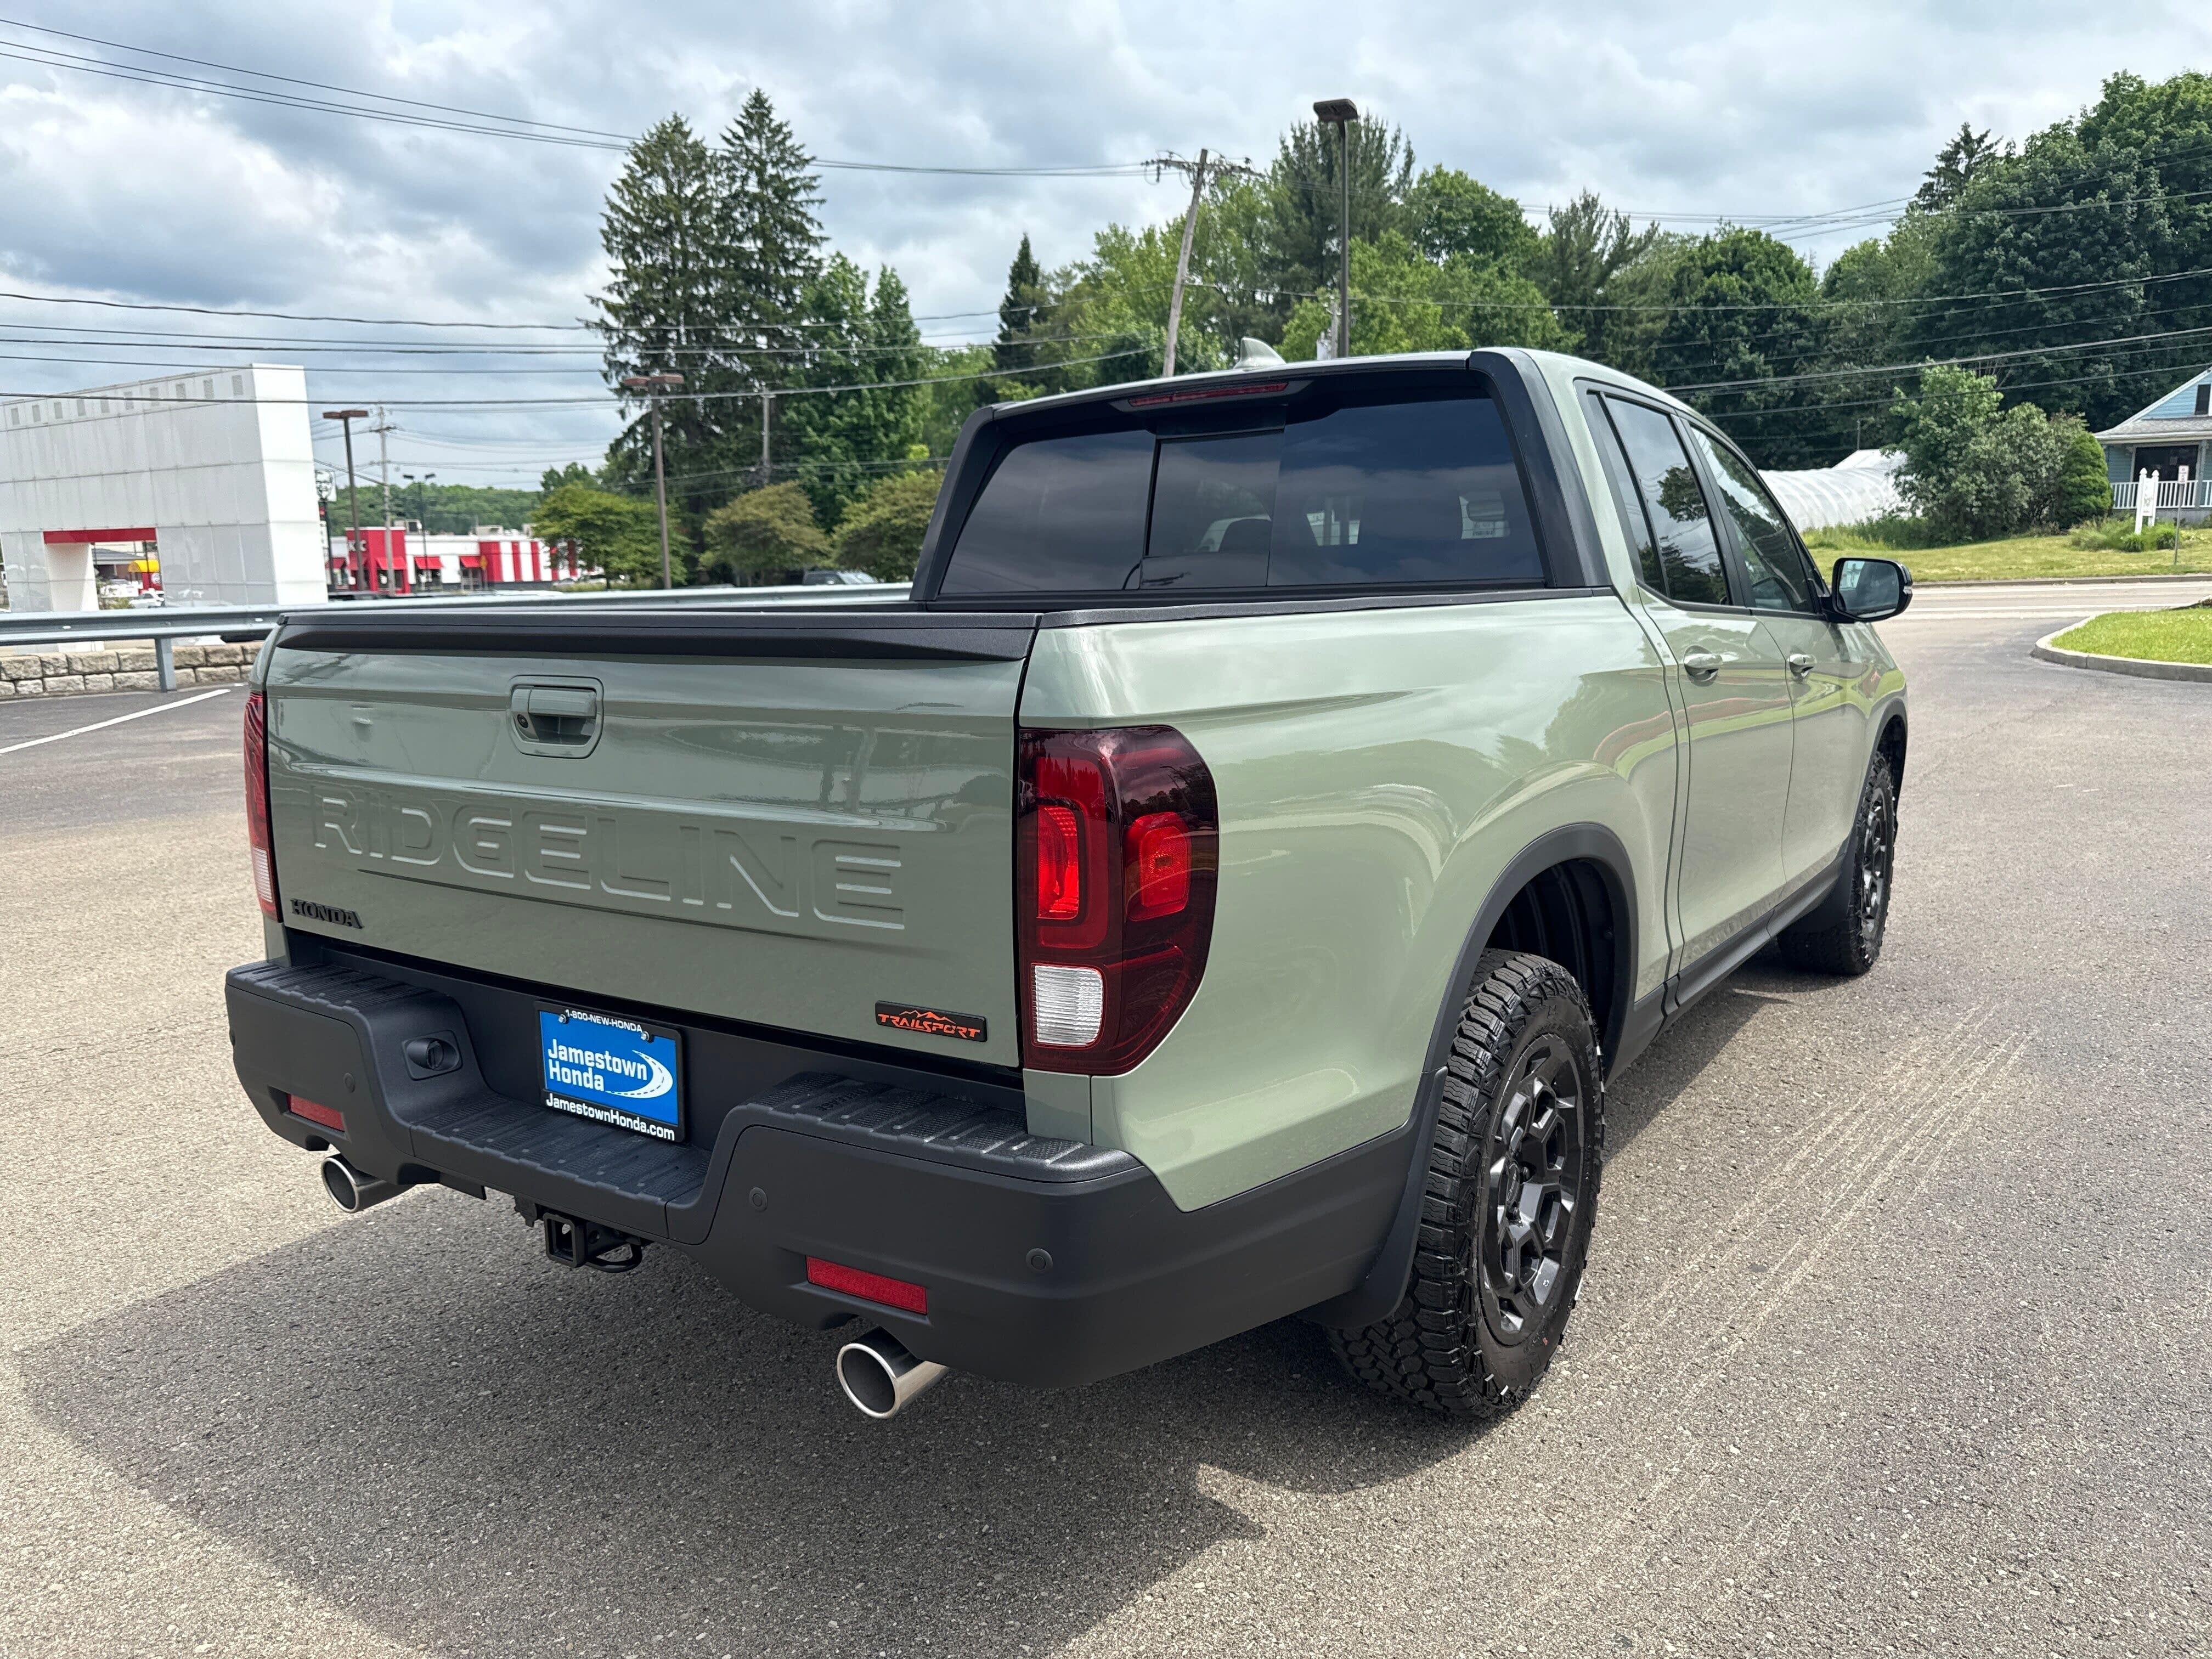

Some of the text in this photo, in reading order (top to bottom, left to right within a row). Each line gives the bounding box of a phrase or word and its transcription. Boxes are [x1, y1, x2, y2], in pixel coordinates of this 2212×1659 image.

[348, 540, 367, 552] KC
[311, 786, 905, 930] RIDGELINE
[290, 898, 365, 929] HONDA
[565, 1009, 644, 1033] 1-800-NEW-HONDA
[877, 1013, 980, 1039] TRAILSPORT
[548, 1039, 648, 1081] Jamestown
[548, 1058, 605, 1092] Honda
[546, 1093, 675, 1141] JamestownHonda.com
